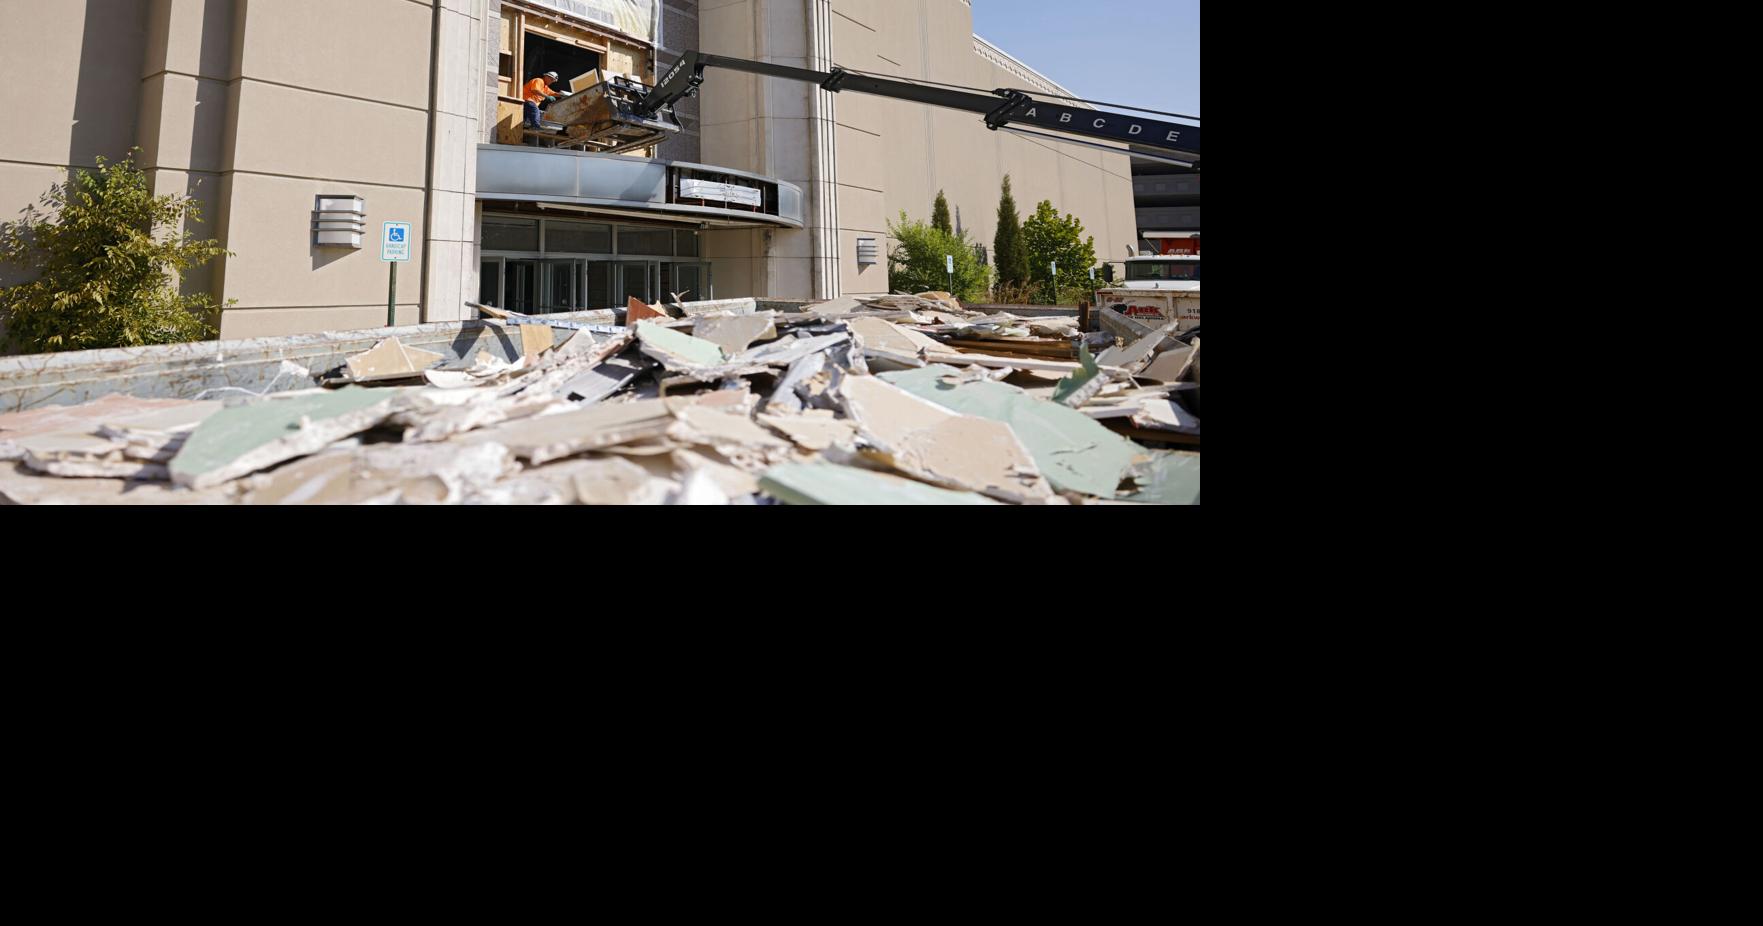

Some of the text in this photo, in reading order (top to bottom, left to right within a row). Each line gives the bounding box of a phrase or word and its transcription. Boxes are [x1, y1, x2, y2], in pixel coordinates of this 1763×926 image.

[1025, 107, 1180, 142] A B C D E
